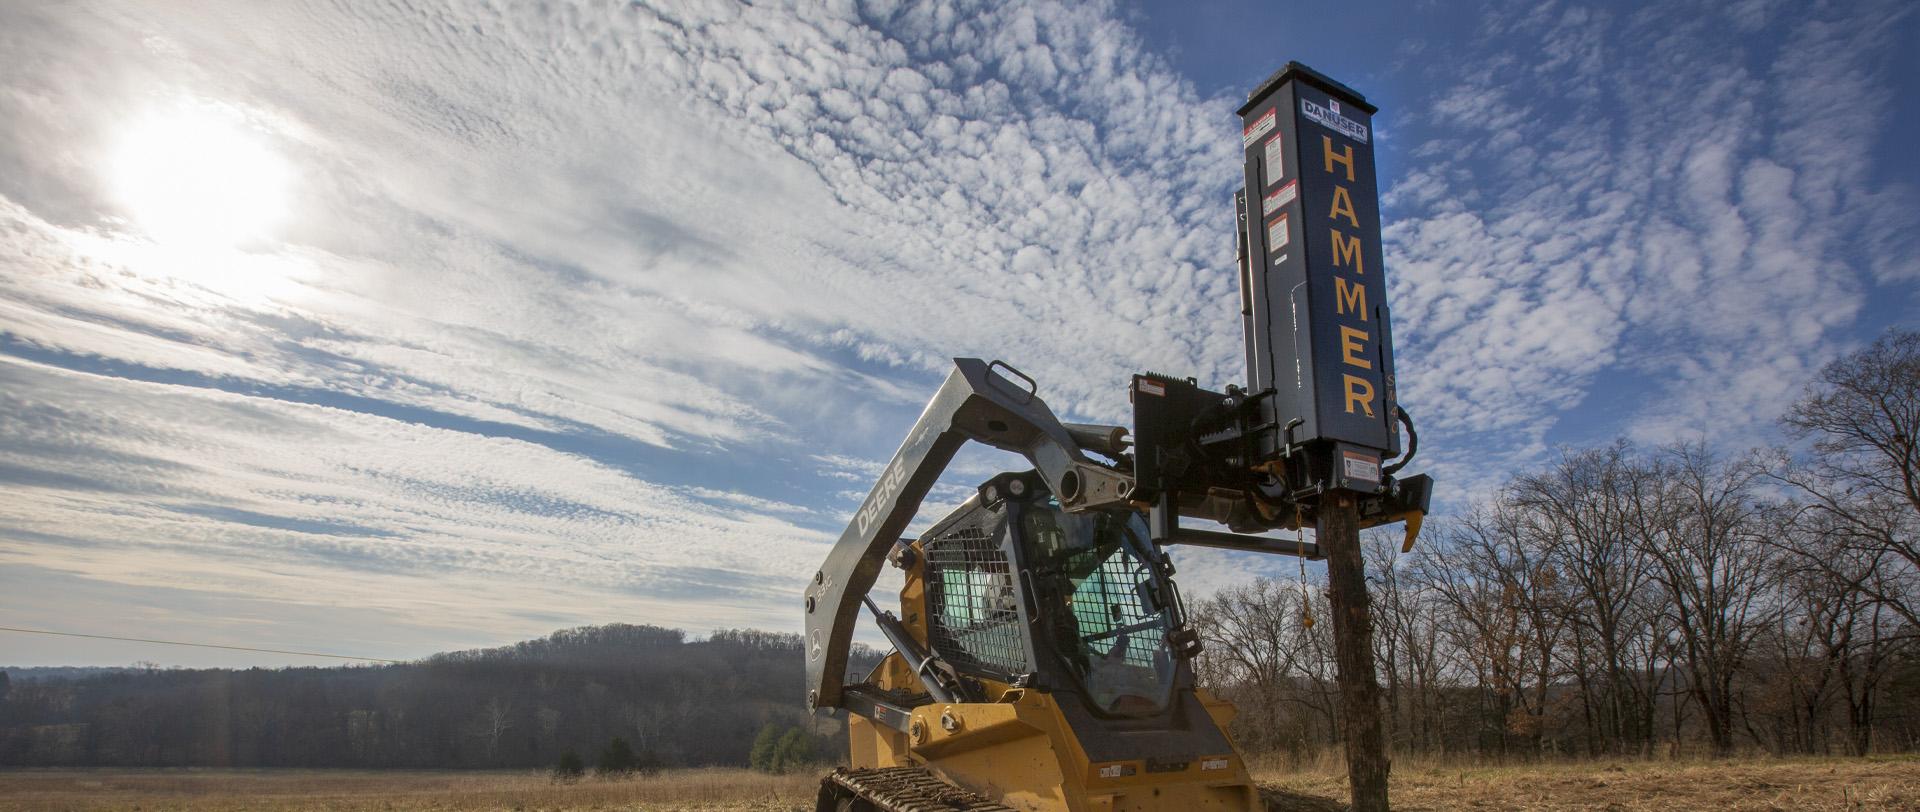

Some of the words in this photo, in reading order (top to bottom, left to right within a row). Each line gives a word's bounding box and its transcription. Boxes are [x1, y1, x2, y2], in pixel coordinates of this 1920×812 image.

[1304, 101, 1366, 138] DANUSER
[1321, 135, 1375, 419] HAMMER
[857, 457, 905, 537] DEERE
